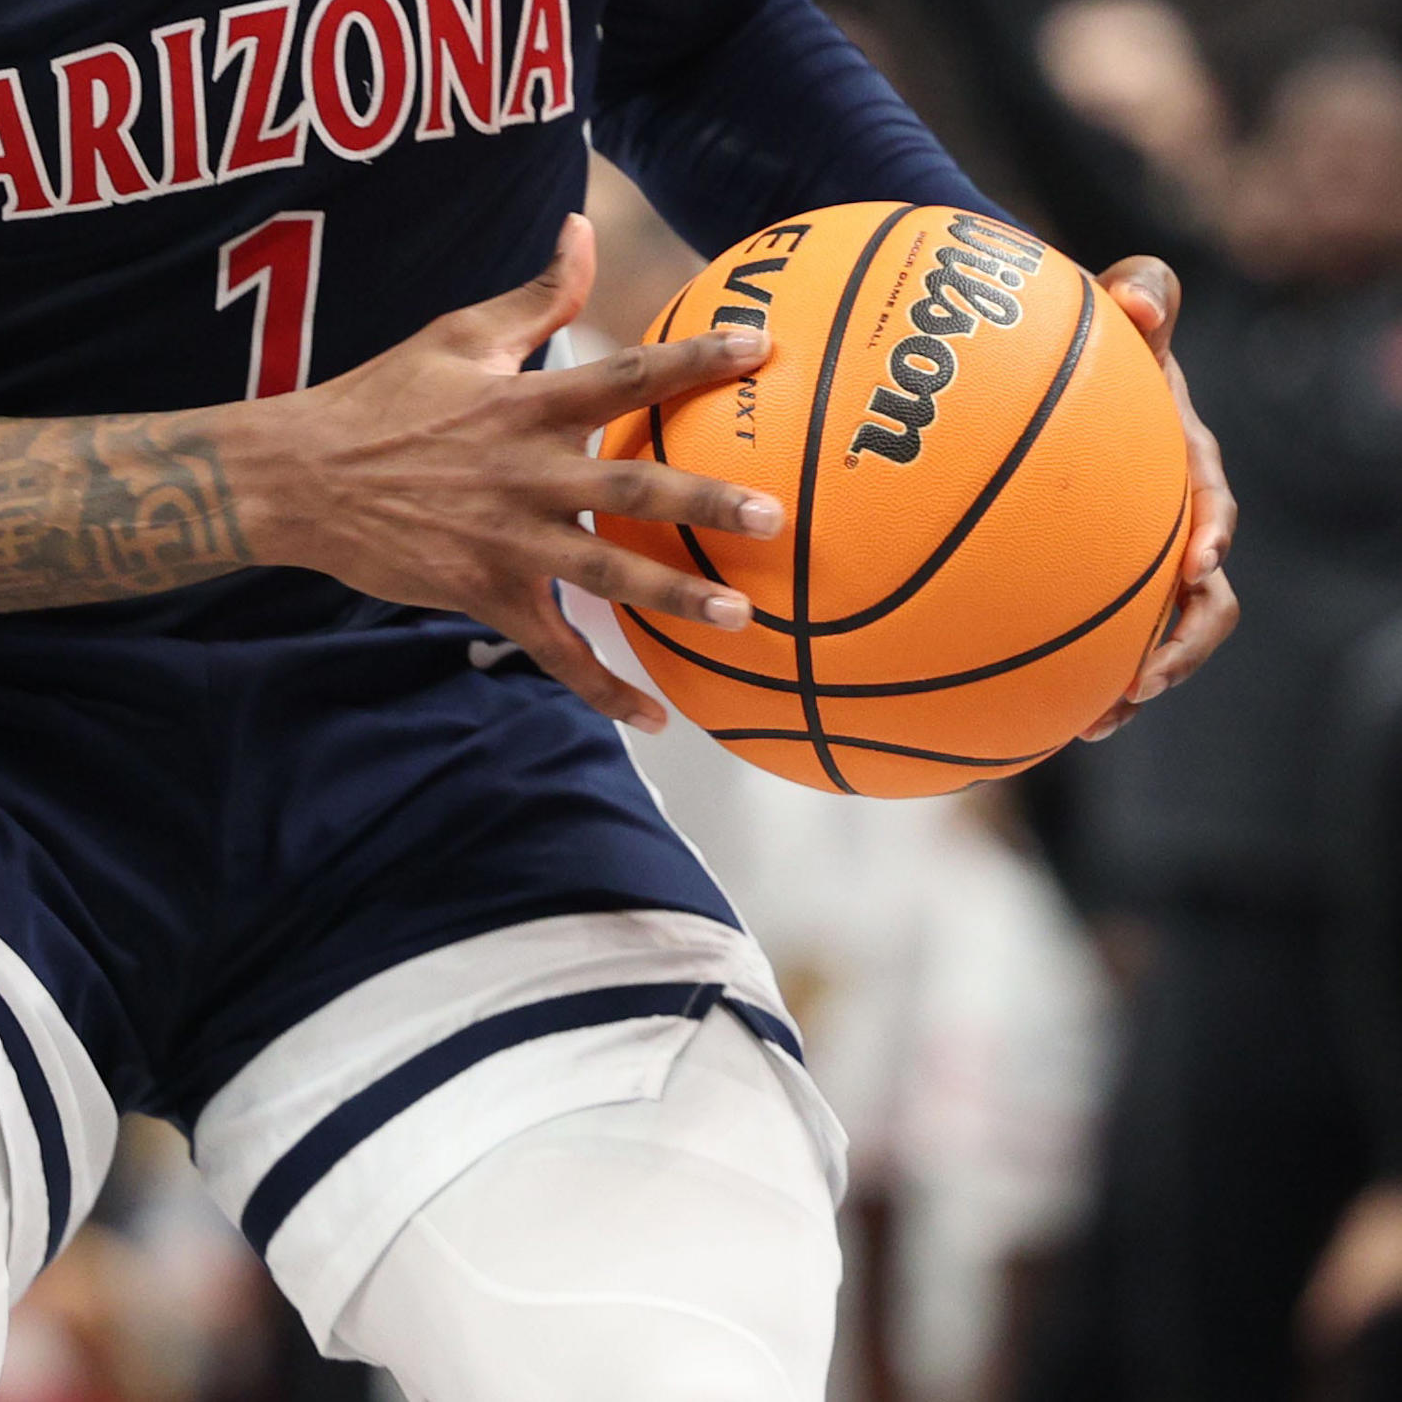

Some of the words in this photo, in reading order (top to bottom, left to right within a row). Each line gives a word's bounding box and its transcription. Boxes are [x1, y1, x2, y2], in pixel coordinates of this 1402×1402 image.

[215, 210, 325, 401] 1
[850, 212, 1047, 465] Wilson
[866, 313, 890, 350] BALL
[736, 376, 758, 450] NXT
